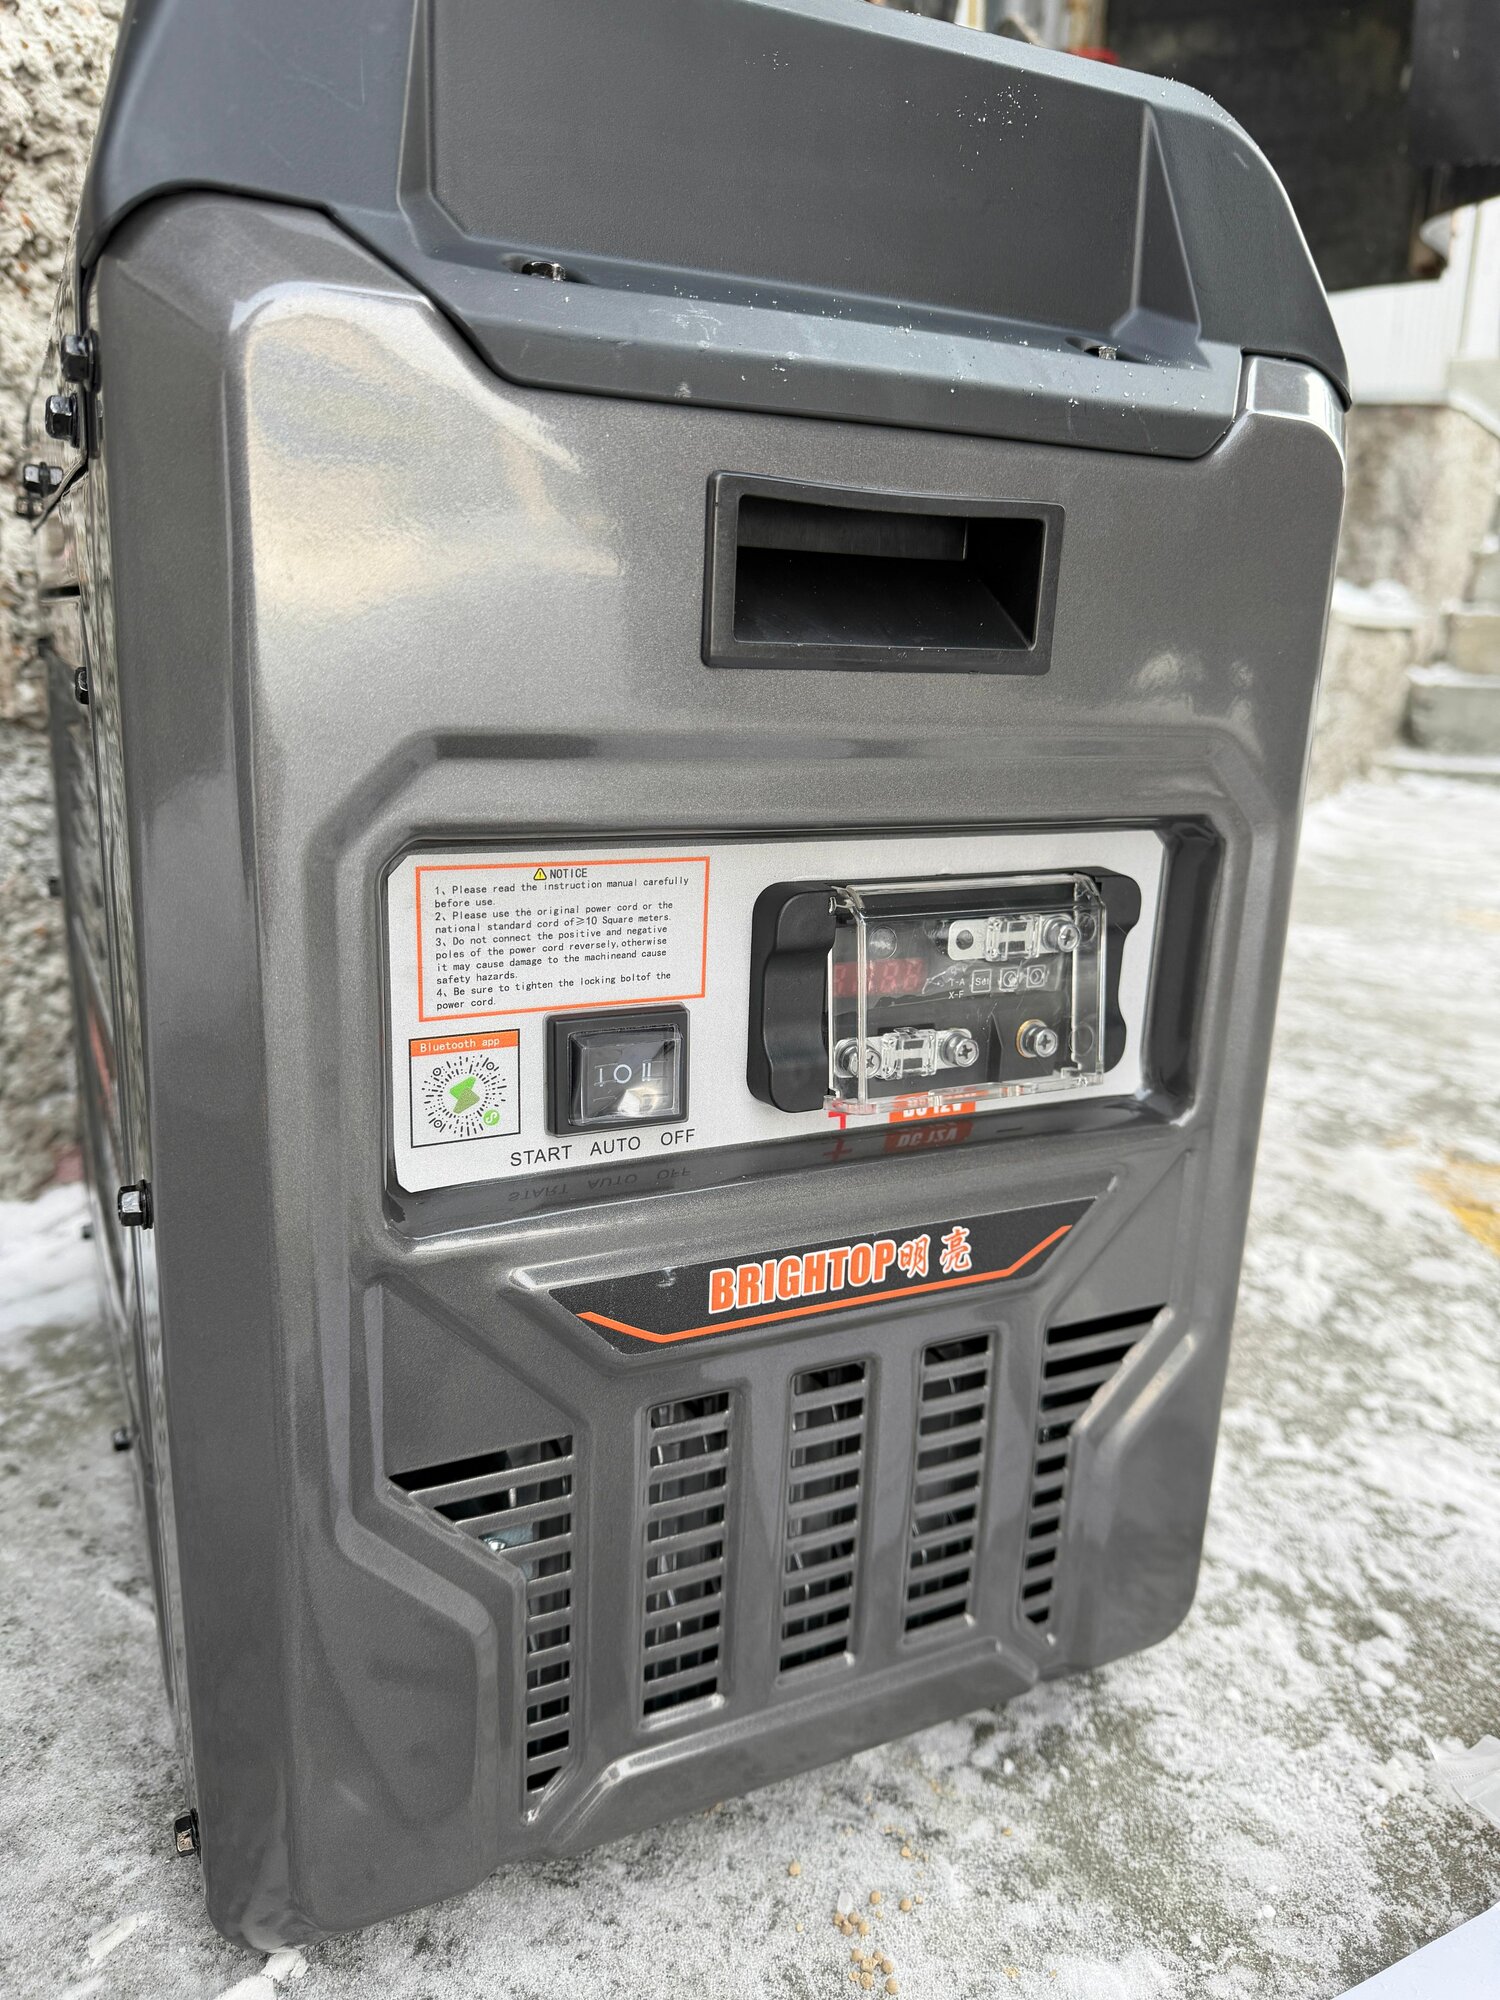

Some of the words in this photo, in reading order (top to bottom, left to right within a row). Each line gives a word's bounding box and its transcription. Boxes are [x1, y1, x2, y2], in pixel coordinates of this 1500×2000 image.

[550, 868, 588, 879] NOTICE
[452, 885, 487, 894] Please
[493, 884, 515, 892] read
[521, 883, 537, 891] the
[544, 881, 602, 891] instruction
[607, 879, 637, 888] manual
[643, 877, 689, 886] carefully
[435, 899, 470, 908] before
[452, 911, 487, 920] Please
[515, 908, 532, 916] the
[538, 906, 579, 916] original
[586, 905, 611, 914] power
[617, 903, 638, 911] cord
[658, 901, 673, 909] the
[435, 923, 480, 934] national
[488, 920, 532, 930] standard
[537, 919, 558, 928] cord
[602, 916, 633, 925] Square
[638, 914, 671, 922] meters.
[452, 937, 464, 946] Do
[470, 936, 487, 944] not
[493, 934, 531, 943] connect
[537, 932, 553, 940] the
[559, 928, 600, 940] positive
[606, 928, 622, 936] and
[627, 926, 667, 935] negative
[436, 951, 464, 960] poles
[470, 948, 481, 957] of
[488, 947, 504, 956] the
[509, 946, 536, 955] power
[542, 943, 564, 952] cord
[437, 964, 447, 972] it
[453, 964, 470, 972] may
[509, 958, 542, 967] damage
[548, 956, 558, 964] to
[564, 954, 580, 962] the
[642, 949, 666, 957] cause
[437, 974, 470, 985] safety
[476, 971, 518, 981] hazards.
[454, 987, 465, 996] Be
[471, 986, 493, 994] sure
[515, 981, 553, 991] tighten
[559, 979, 574, 987] the
[580, 975, 616, 986] locking
[656, 972, 671, 980] the
[436, 1001, 464, 1011] power
[471, 997, 496, 1007] cord.
[420, 1038, 476, 1052] Bluetooth
[482, 1038, 500, 1047] app
[510, 1144, 572, 1166] START
[590, 1136, 641, 1156] AUTO
[660, 1128, 695, 1146] OFF
